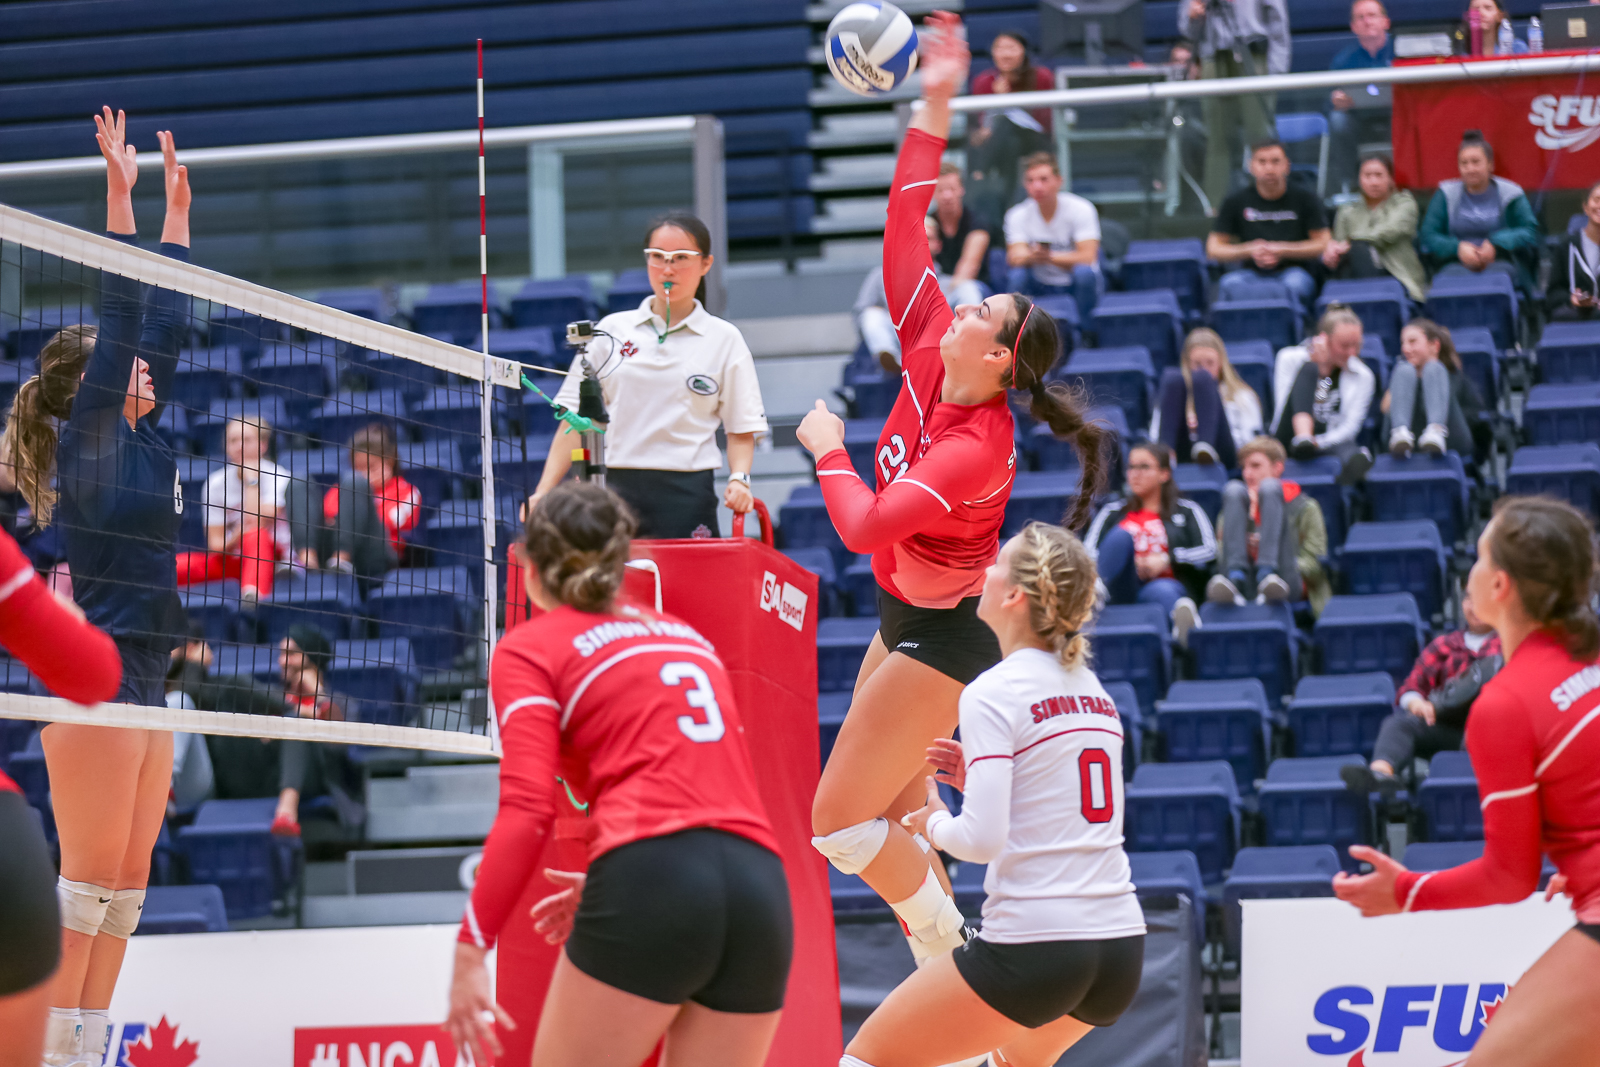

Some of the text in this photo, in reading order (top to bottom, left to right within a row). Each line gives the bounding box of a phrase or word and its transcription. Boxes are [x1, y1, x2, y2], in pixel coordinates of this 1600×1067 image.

[1528, 94, 1600, 127] SFU
[572, 621, 651, 658] SIMON
[659, 661, 726, 743] 3
[1030, 695, 1080, 724] SIMON
[1549, 664, 1600, 712] SIMO
[1077, 747, 1114, 824] 0
[1306, 983, 1507, 1056] SFU
